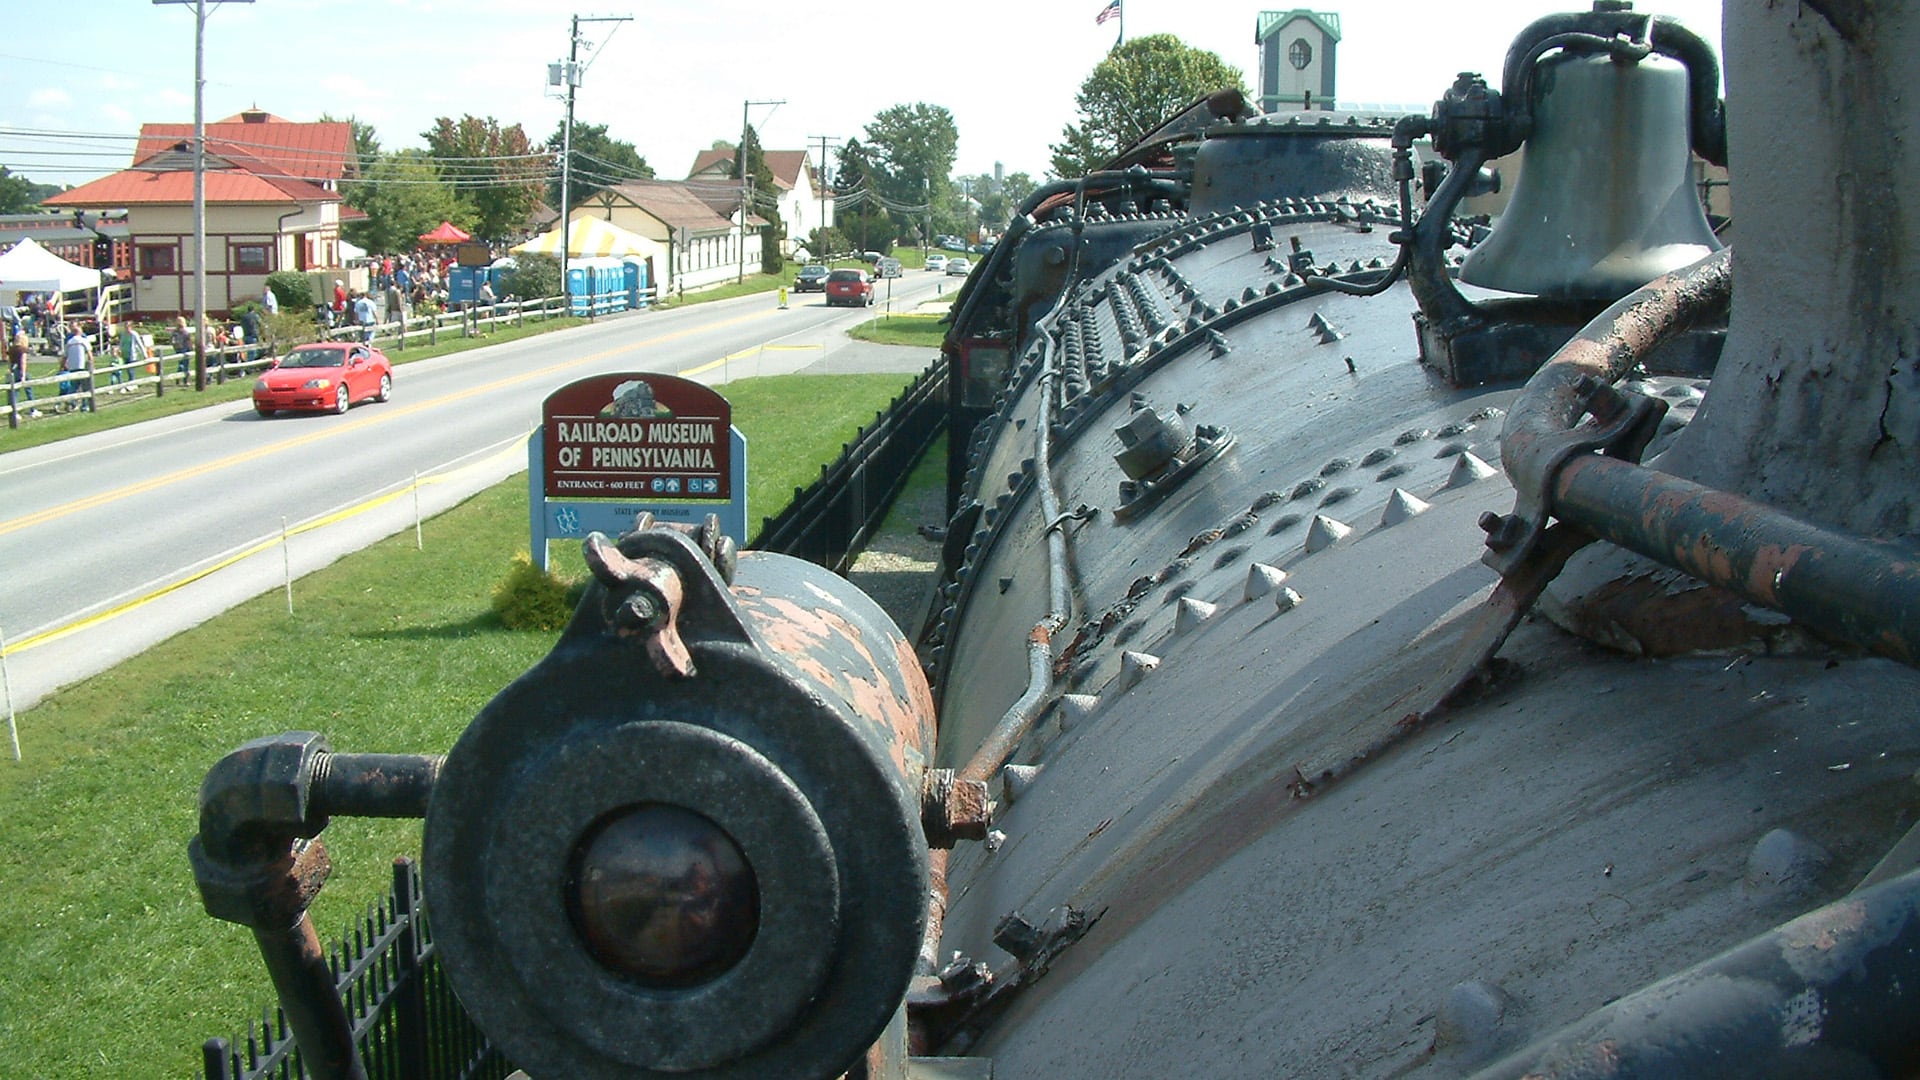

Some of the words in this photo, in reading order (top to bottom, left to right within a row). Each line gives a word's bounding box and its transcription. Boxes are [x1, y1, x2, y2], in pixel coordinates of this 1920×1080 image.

[558, 422, 642, 443] RAILROAD
[648, 423, 714, 443] MUSEUM
[559, 447, 582, 467] OF
[592, 448, 714, 468] PENNSYLVANIA
[557, 480, 604, 488] ENTRANCE
[610, 481, 624, 489] 600
[624, 481, 645, 489] FEET
